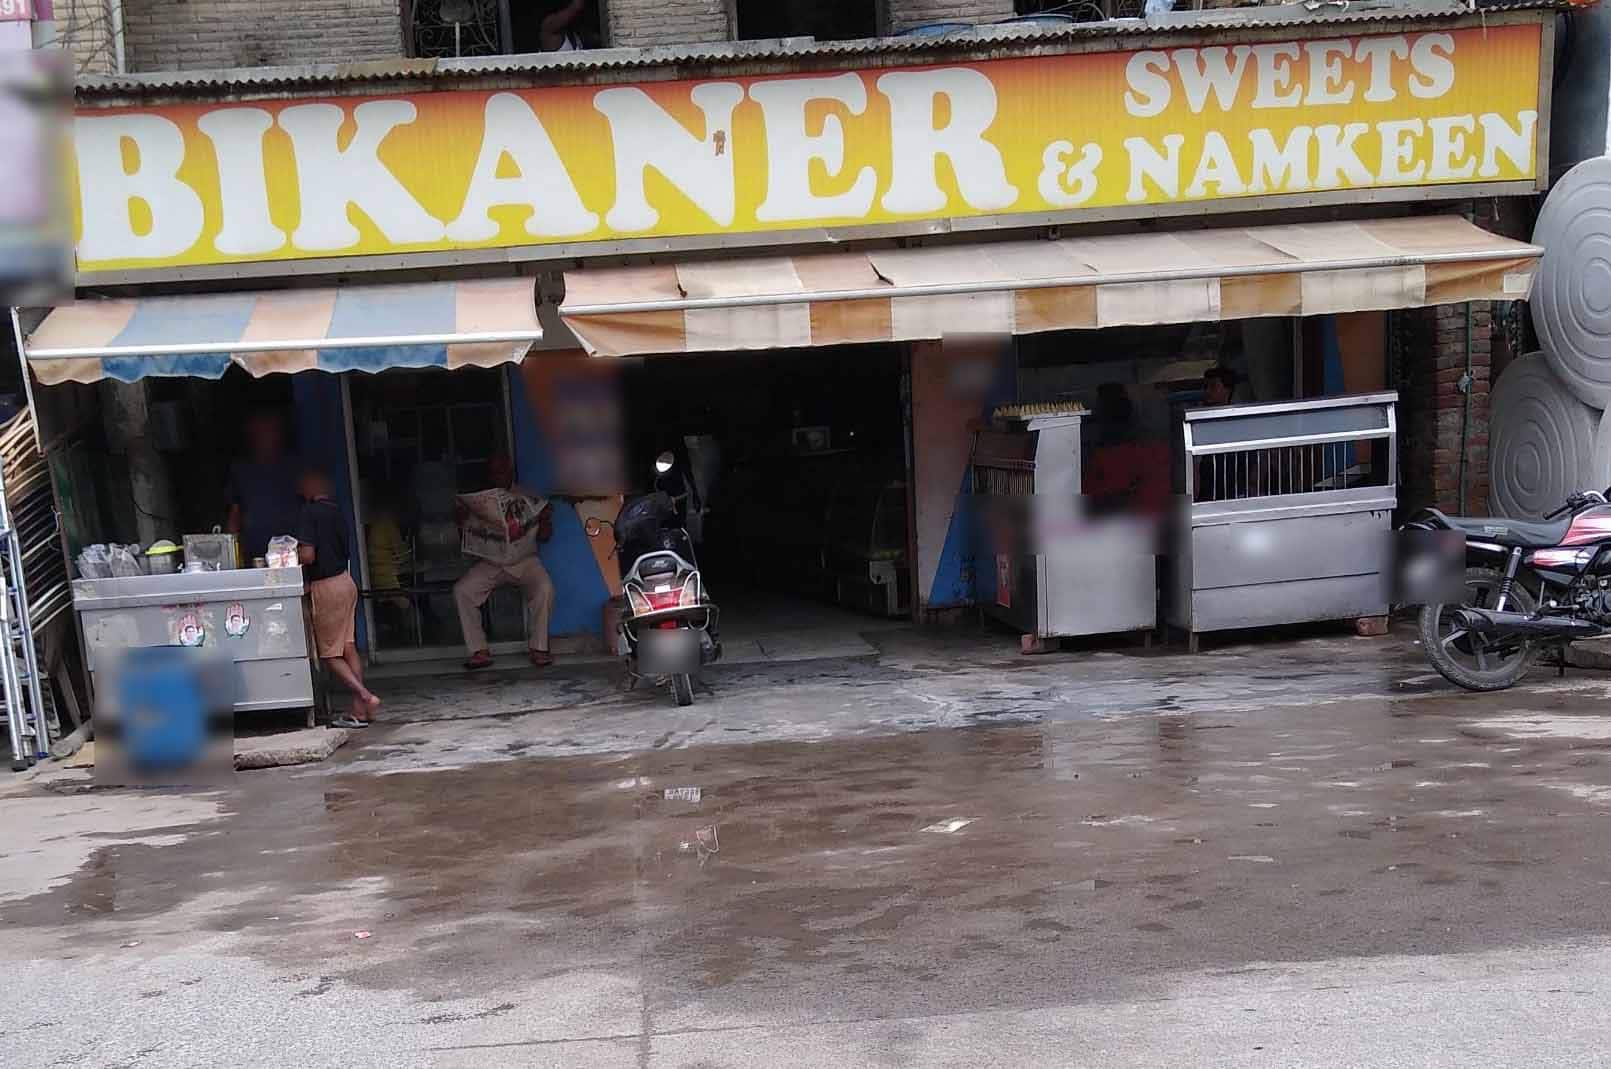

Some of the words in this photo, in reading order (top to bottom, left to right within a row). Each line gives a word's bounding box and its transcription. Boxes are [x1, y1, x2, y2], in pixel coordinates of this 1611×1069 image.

[1124, 33, 1456, 118] SWEETS
[76, 67, 1018, 261] BIKANER
[1037, 140, 1103, 206] &
[1124, 109, 1538, 203] NAMKEEN
